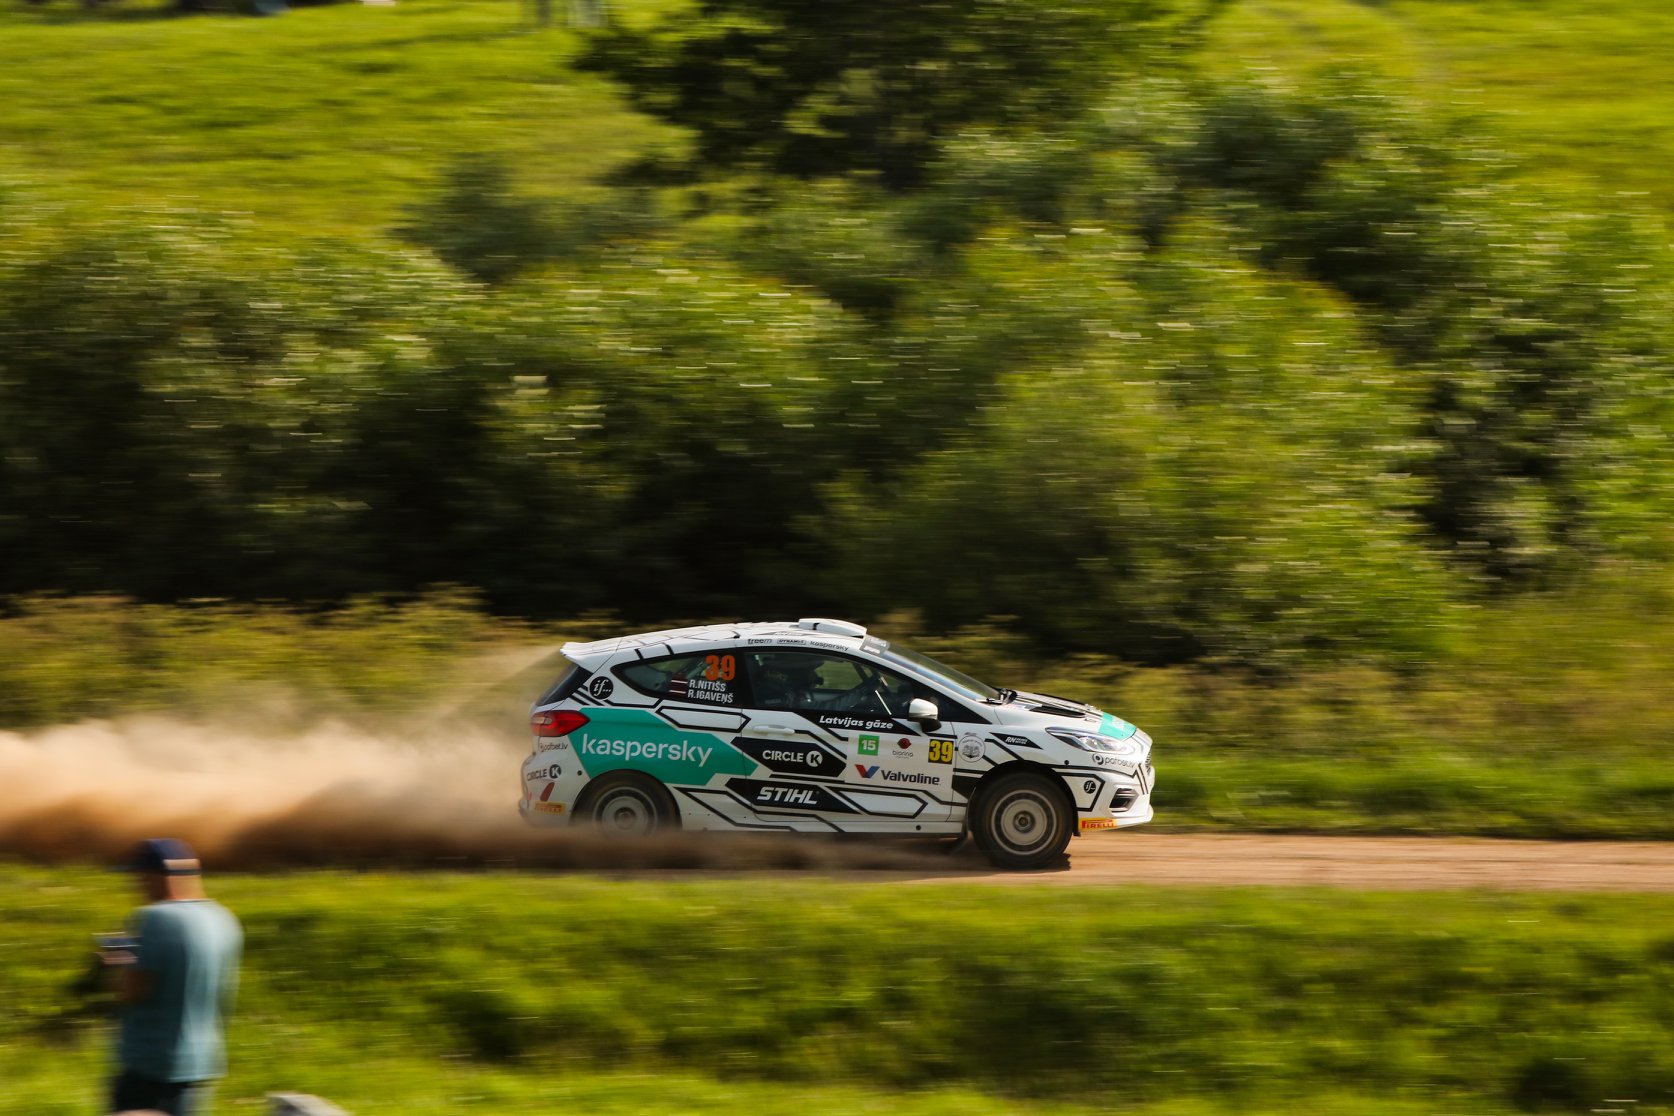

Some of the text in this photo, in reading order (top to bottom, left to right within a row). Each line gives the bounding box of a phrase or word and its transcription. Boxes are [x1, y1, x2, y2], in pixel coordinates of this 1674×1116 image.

[705, 655, 736, 681] 39
[689, 679, 726, 692] R.NITIŠS
[819, 715, 894, 730] Latvijas gāze
[582, 733, 713, 768] kaspersky
[861, 739, 876, 751] 15
[929, 740, 953, 762] 39
[762, 750, 804, 762] CIRCLE
[526, 769, 548, 781] CIRCLE
[881, 770, 940, 786] Valvoline
[757, 786, 818, 805] STIHL
[1081, 820, 1115, 829] PIRELLI
